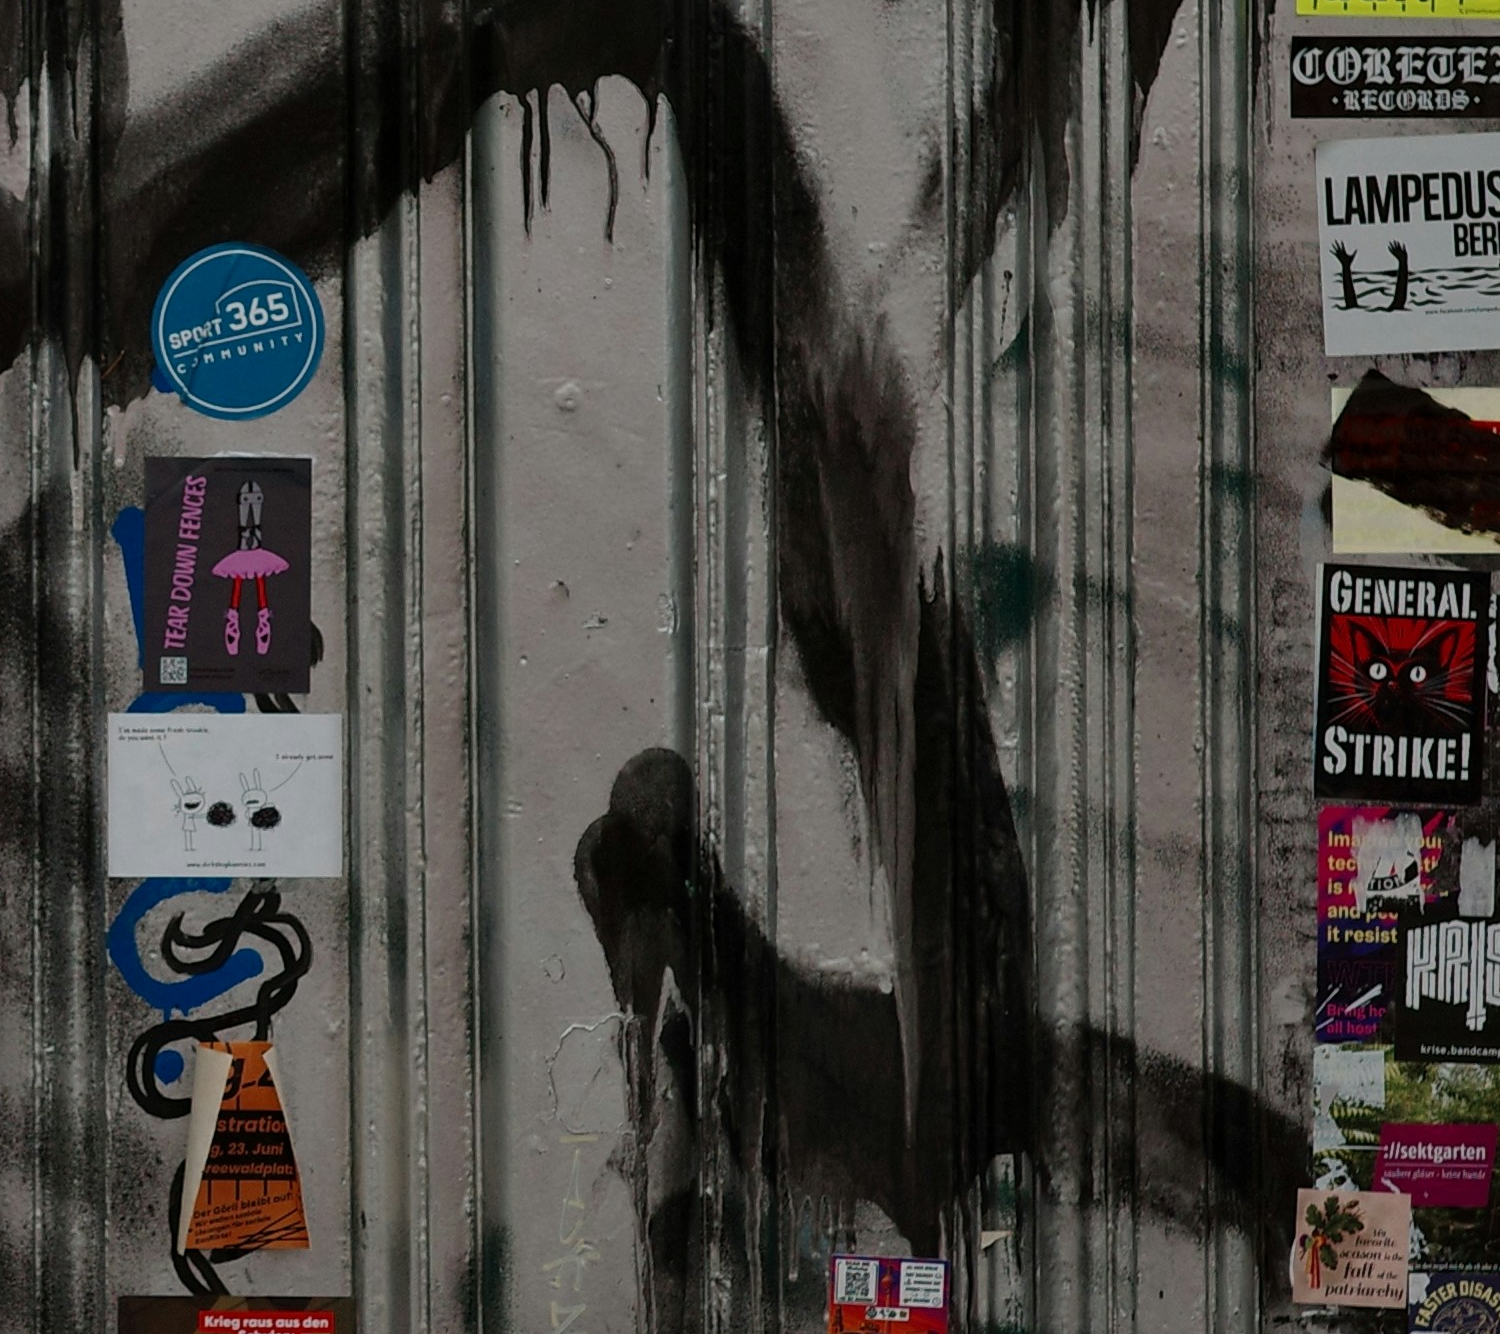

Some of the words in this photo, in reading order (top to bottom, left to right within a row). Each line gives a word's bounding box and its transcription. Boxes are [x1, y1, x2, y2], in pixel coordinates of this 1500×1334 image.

[168, 317, 222, 352] SPORT
[225, 291, 290, 332] 365
[179, 475, 208, 540] FENCES
[170, 543, 199, 602] DOWN
[1329, 569, 1478, 620] GENERAL
[164, 604, 190, 649] TEAR
[1322, 724, 1470, 782] STRIKE!
[204, 1315, 240, 1330] Krieg
[243, 1318, 273, 1328] raus
[275, 1318, 299, 1328] aus
[302, 1317, 328, 1328] den
